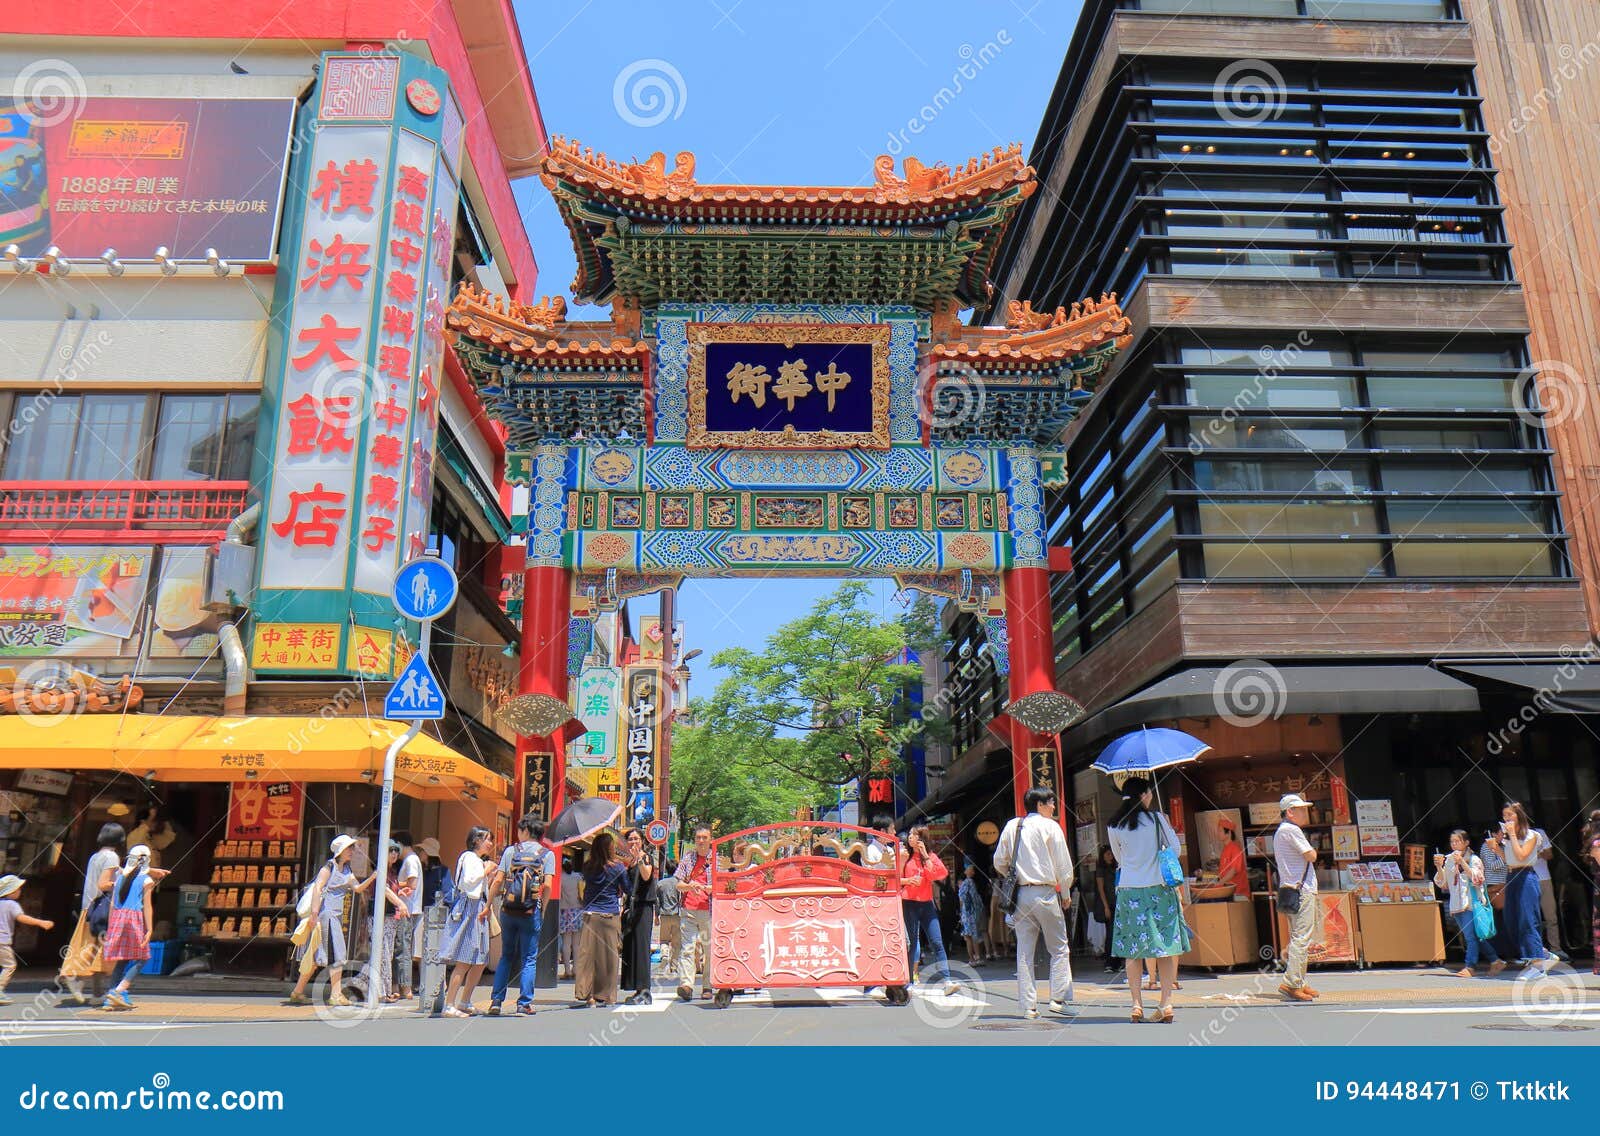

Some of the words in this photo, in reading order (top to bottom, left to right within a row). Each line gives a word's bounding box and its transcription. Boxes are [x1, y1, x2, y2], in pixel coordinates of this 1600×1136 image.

[60, 176, 180, 194] 1888年創業
[54, 199, 269, 214] 伝統を守り続けてきた本場の味
[272, 158, 379, 548] 横浜大飯店
[262, 628, 335, 649] 中華街
[260, 651, 333, 664] 大通り入口
[358, 633, 381, 669] 入口
[584, 694, 610, 755] 楽園
[234, 782, 299, 839] 甘栗
[651, 827, 665, 839] 30
